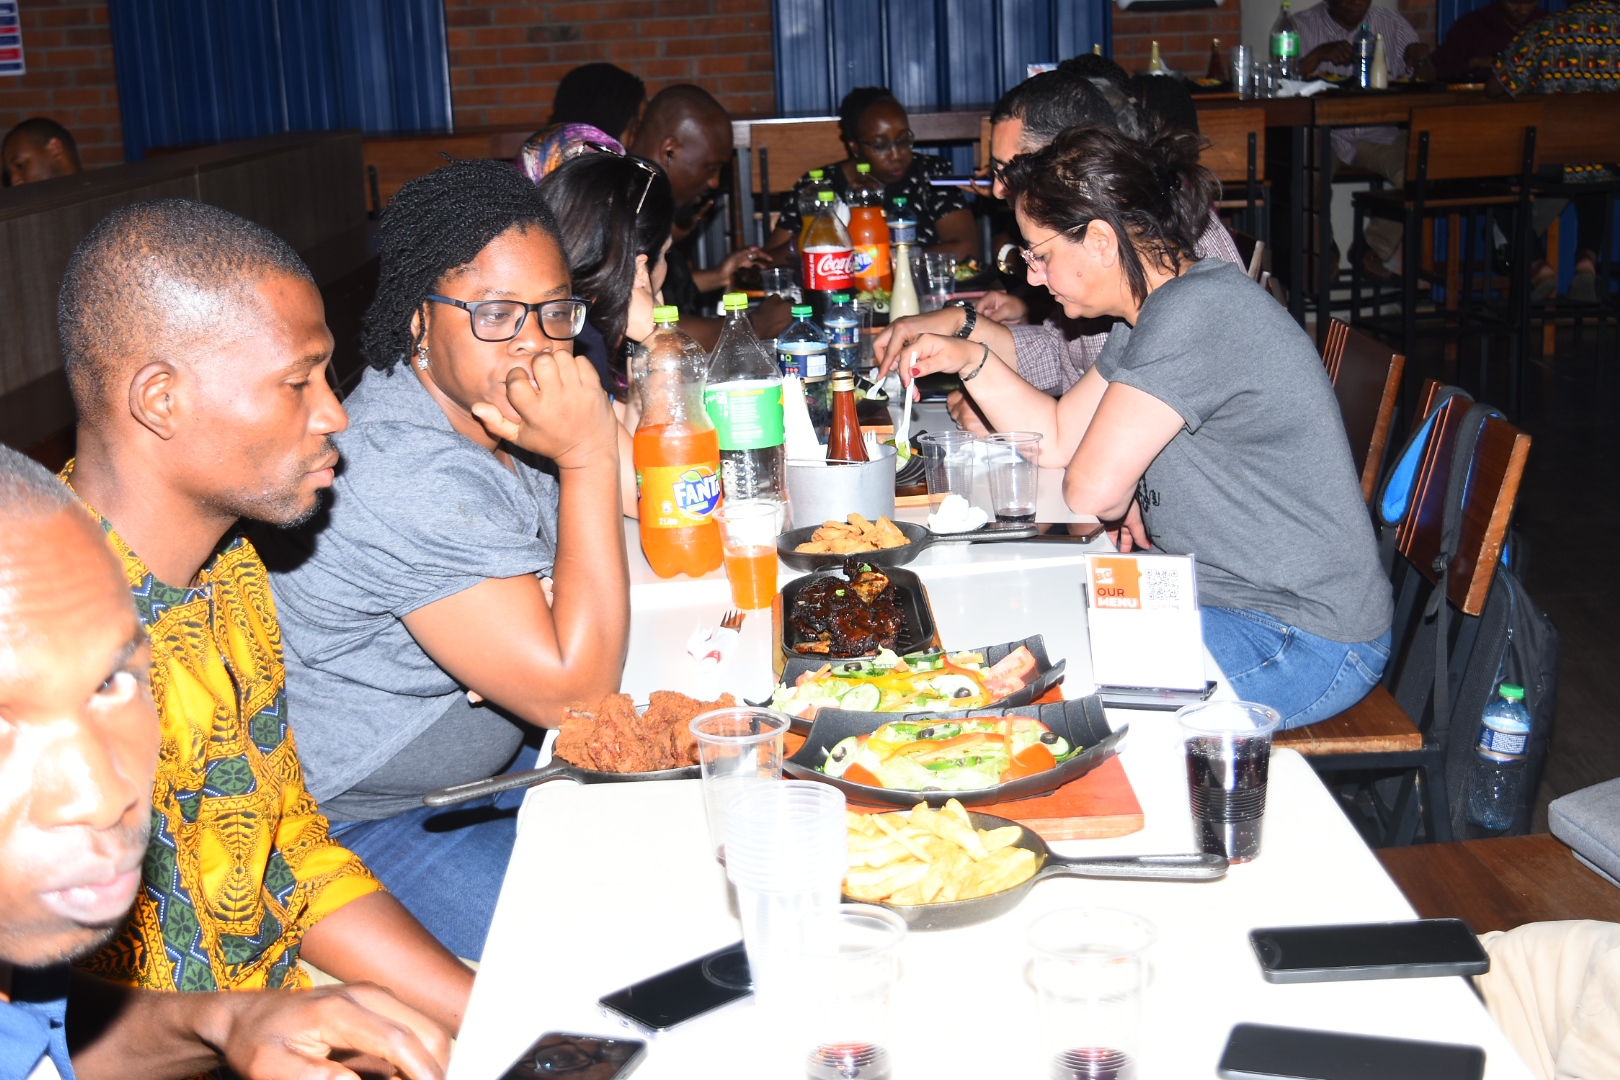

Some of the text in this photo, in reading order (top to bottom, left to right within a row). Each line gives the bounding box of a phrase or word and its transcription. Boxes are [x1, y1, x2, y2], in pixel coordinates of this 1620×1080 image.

[673, 475, 720, 508] FANTA
[1097, 587, 1125, 597] OUR
[1097, 597, 1137, 607] MENU
